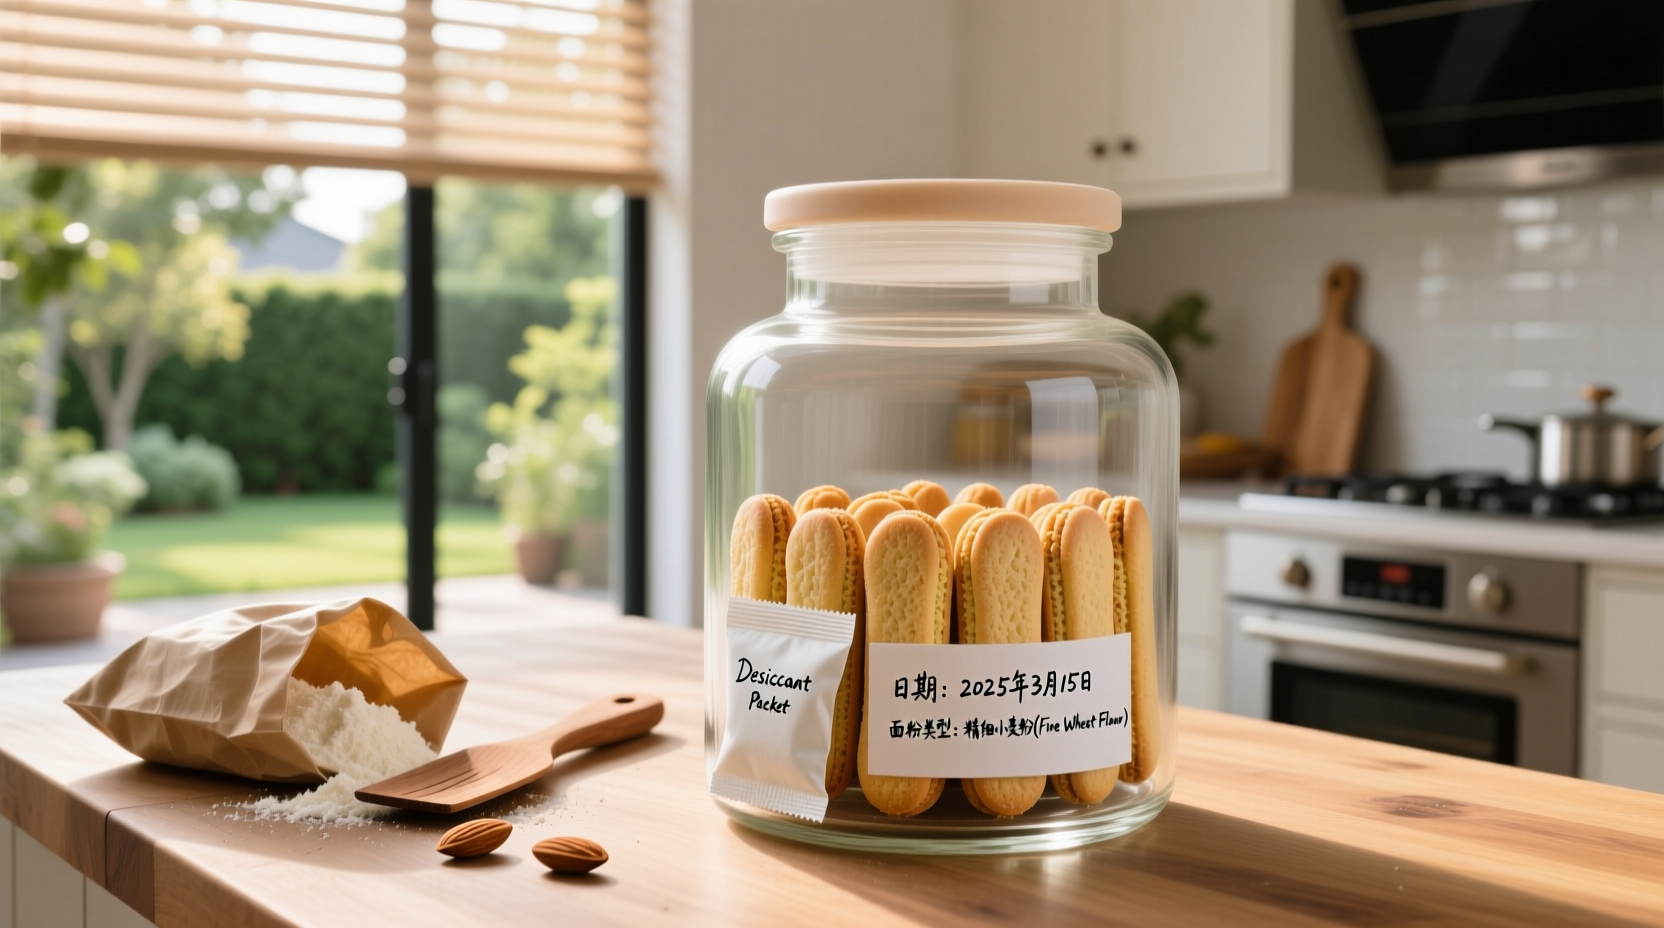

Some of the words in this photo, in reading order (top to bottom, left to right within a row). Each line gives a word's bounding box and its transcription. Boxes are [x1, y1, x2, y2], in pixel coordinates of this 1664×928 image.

[735, 657, 813, 692] Desiccant
[959, 669, 1092, 704] 2025年3月15日
[748, 690, 791, 714] Packet
